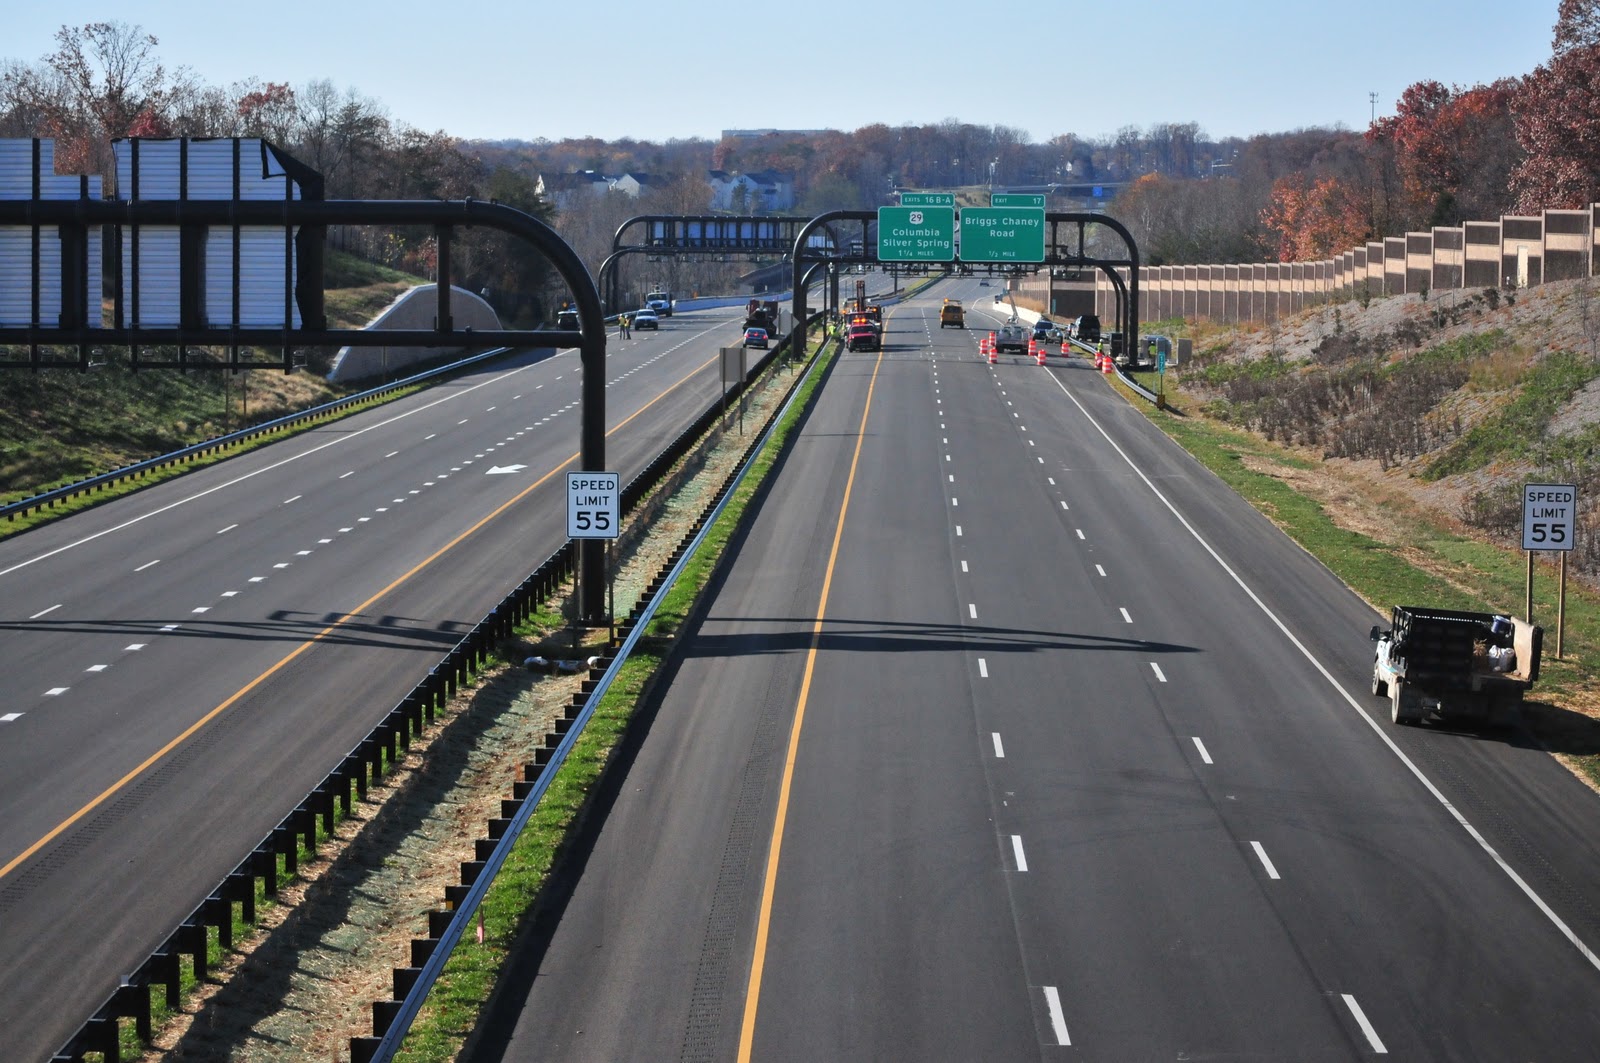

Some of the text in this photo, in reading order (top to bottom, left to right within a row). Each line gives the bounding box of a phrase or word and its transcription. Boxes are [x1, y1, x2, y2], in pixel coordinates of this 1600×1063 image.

[965, 217, 1040, 227] Briggs Chaney
[917, 239, 950, 248] Spring
[572, 480, 614, 490] SPEED
[576, 496, 609, 506] LIMIT
[1528, 492, 1572, 502] SPEED
[1532, 508, 1566, 518] LIMIT
[576, 512, 610, 530] 55
[1532, 524, 1566, 543] 55
